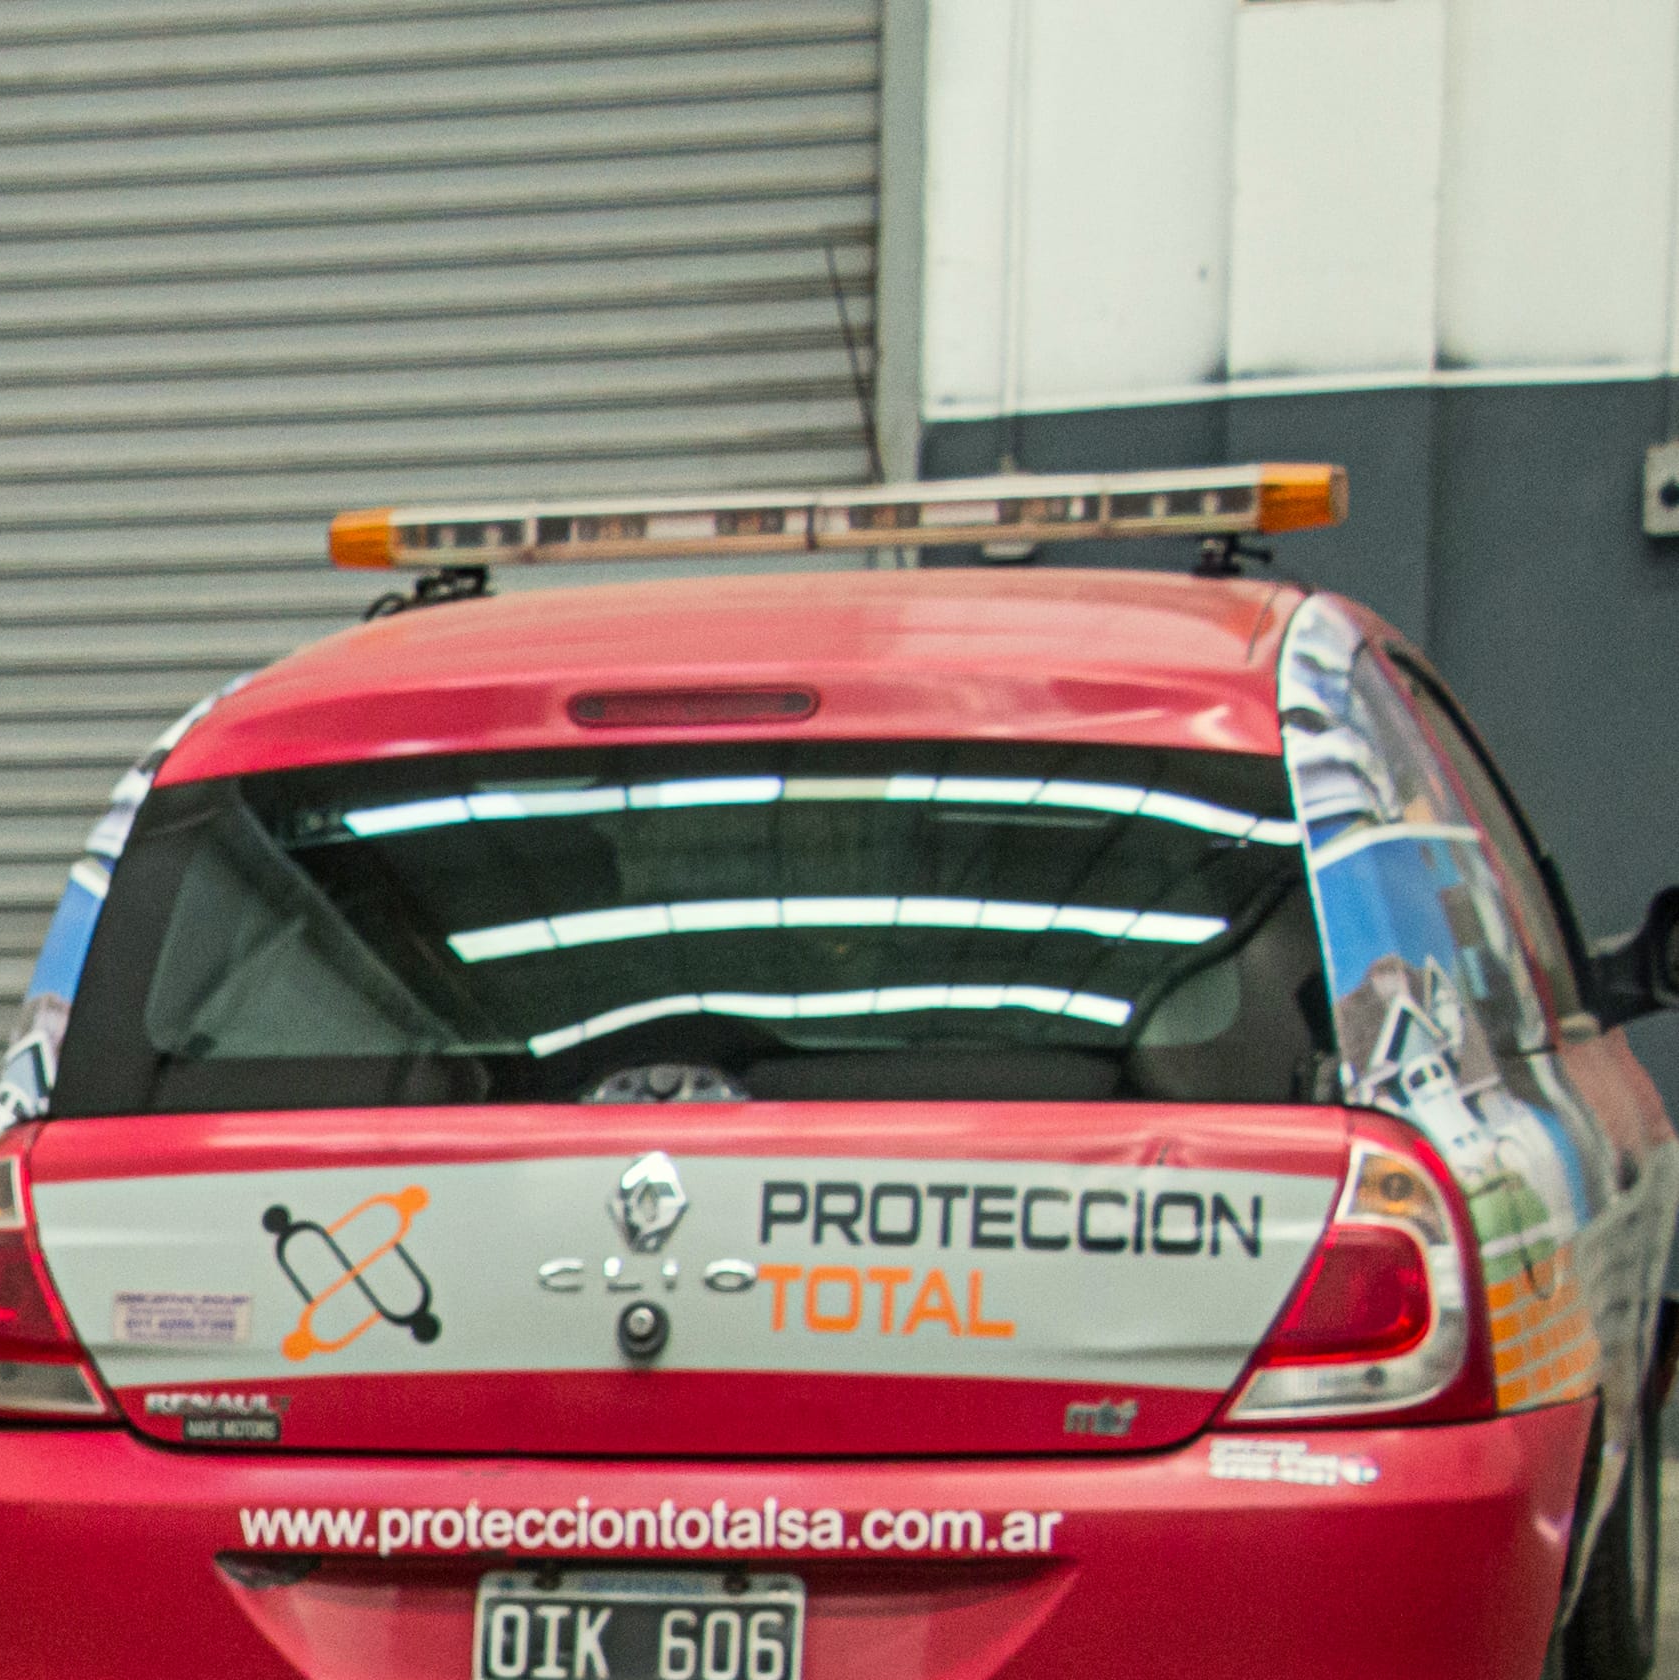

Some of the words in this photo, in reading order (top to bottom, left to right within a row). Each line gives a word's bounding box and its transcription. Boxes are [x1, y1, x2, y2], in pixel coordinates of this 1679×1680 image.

[758, 1181, 1263, 1258] PROTECCION
[538, 1256, 757, 1293] CLIO
[757, 1262, 1017, 1339] TOTAL
[239, 1497, 1064, 1558] www.protecciontotalsa.com.ar
[489, 1603, 613, 1680] OIK
